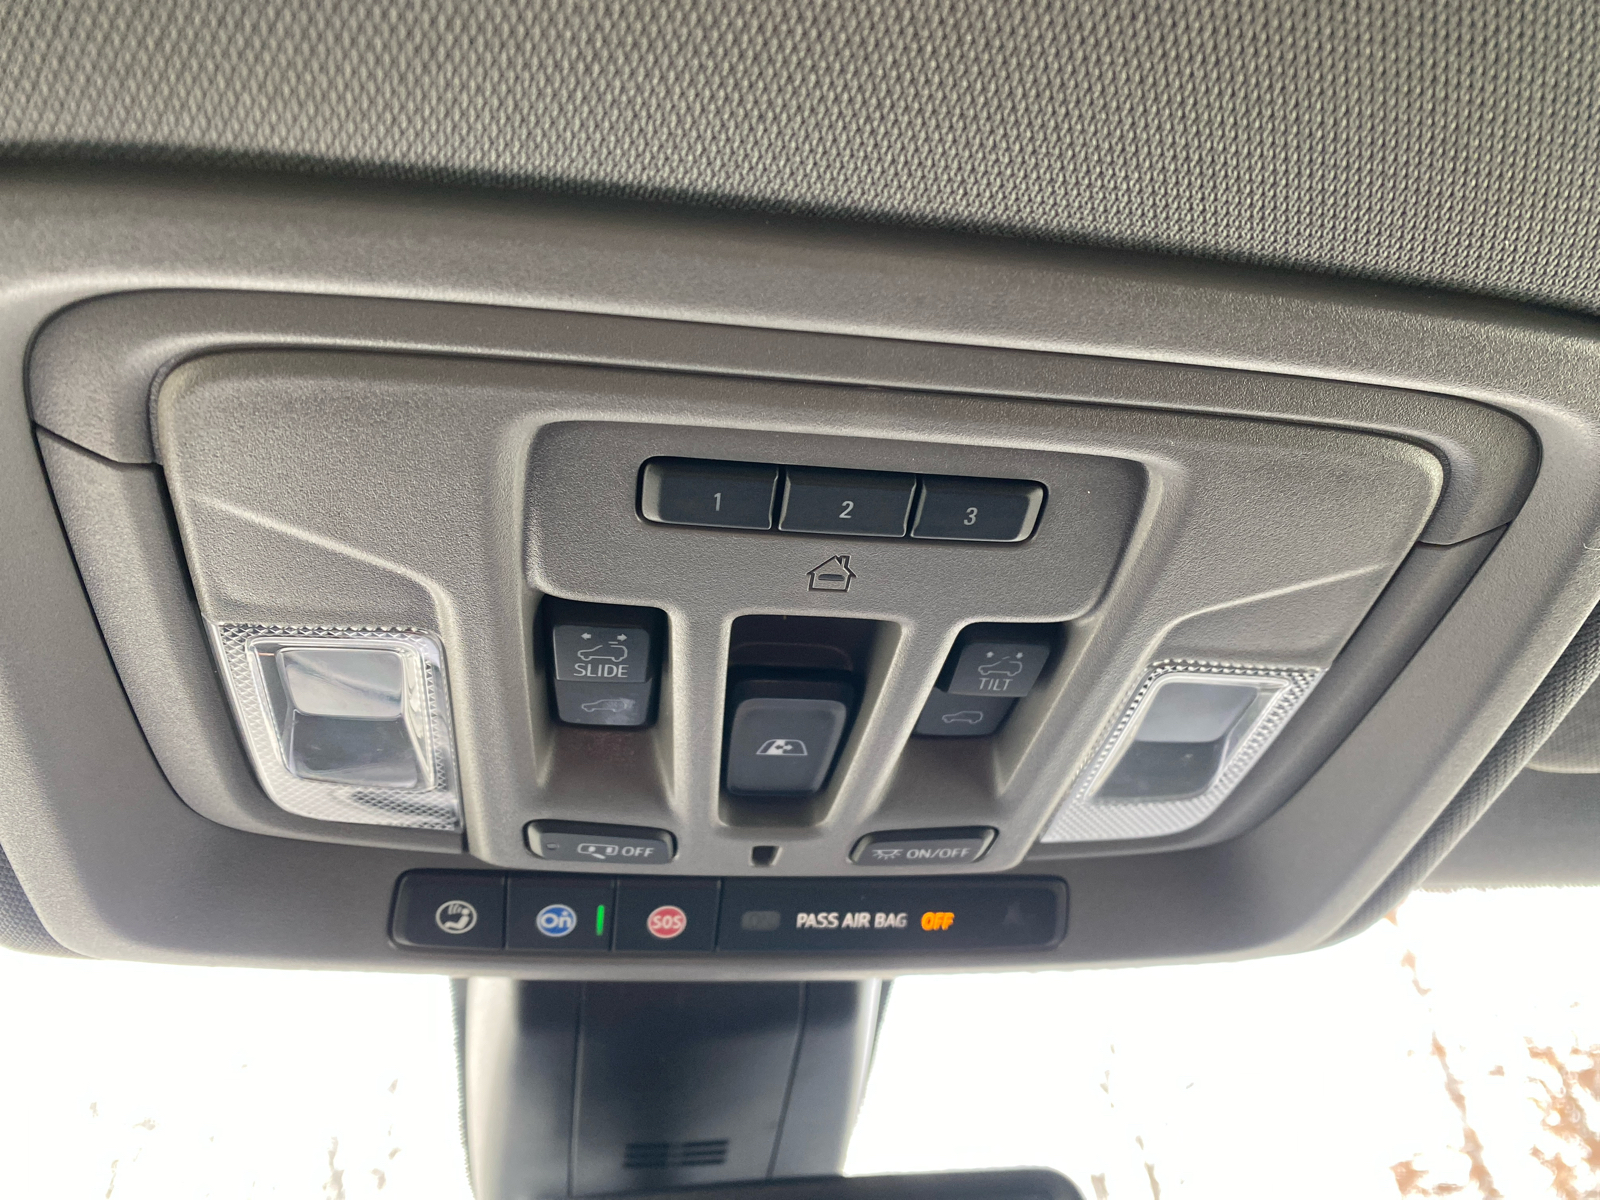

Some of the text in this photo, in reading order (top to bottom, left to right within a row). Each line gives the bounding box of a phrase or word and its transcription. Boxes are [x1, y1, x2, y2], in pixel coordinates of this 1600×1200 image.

[714, 492, 722, 511] 1
[839, 500, 854, 519] 2
[963, 507, 978, 526] 3
[573, 662, 629, 678] SLIDE
[978, 677, 1013, 691] TILT
[621, 846, 654, 857] OFF
[906, 847, 970, 859] ON/OFF
[652, 914, 682, 930] SOS
[796, 912, 839, 928] PASS
[841, 912, 871, 928] AIR
[874, 912, 908, 928] BAG
[921, 911, 955, 931] OFF
